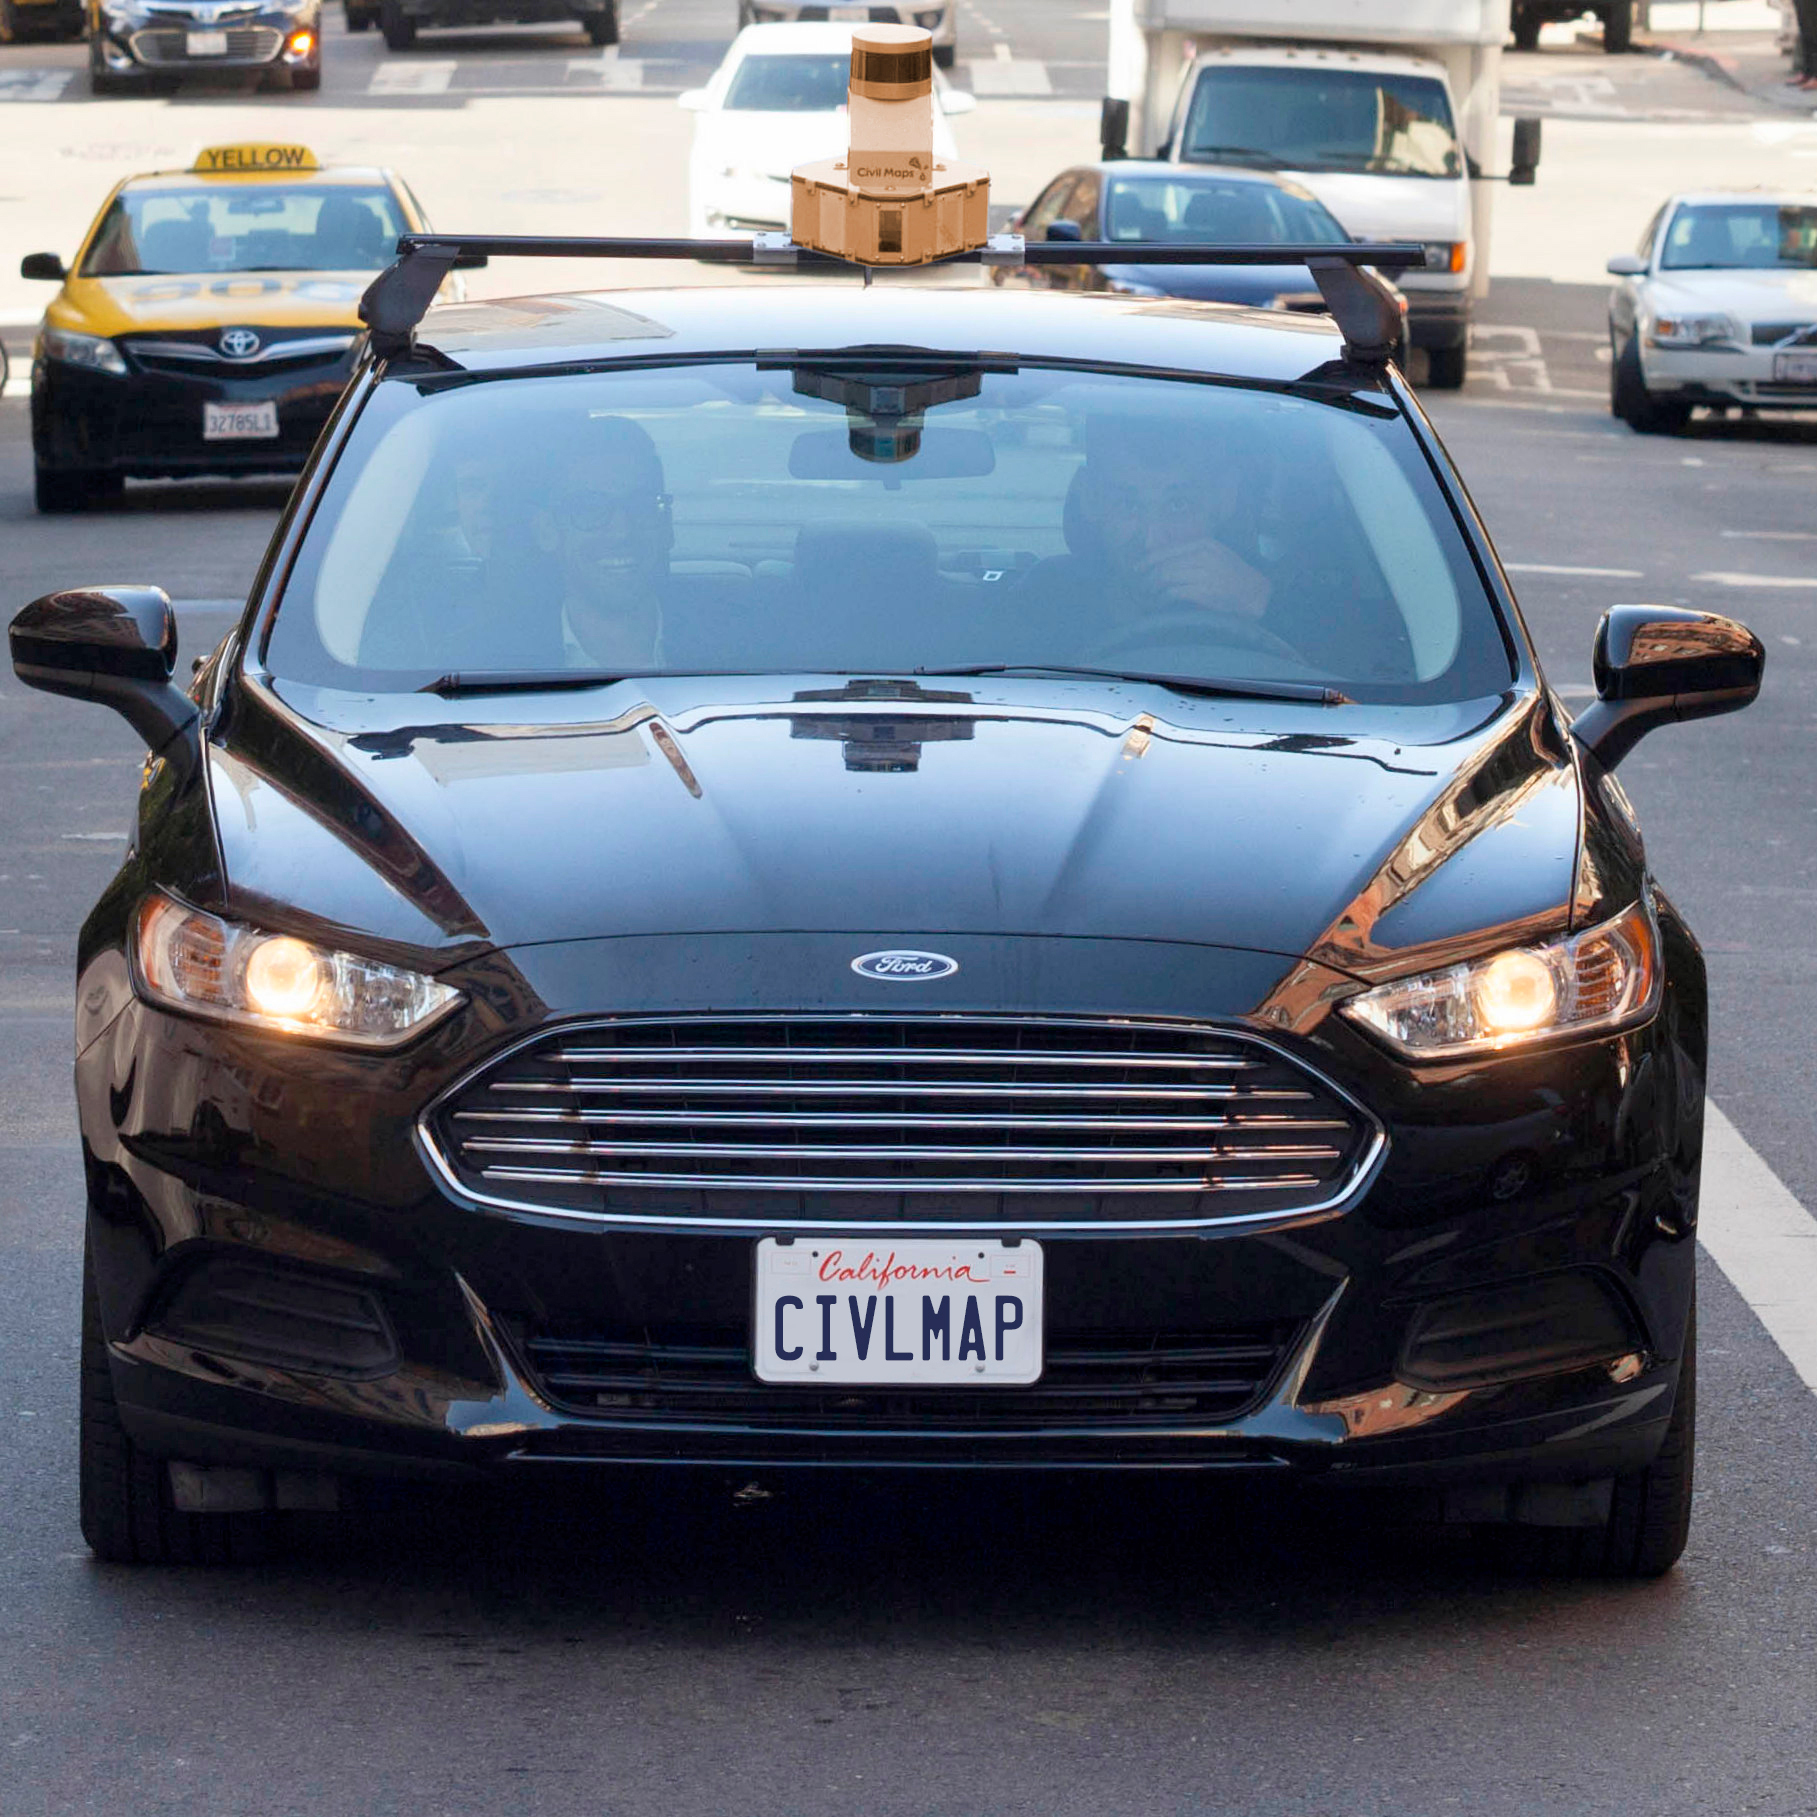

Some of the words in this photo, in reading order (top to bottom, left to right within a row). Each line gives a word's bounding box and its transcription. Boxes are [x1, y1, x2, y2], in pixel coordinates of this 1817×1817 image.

[207, 147, 305, 169] YELLOW
[857, 167, 882, 178] Civil
[883, 167, 915, 179] Maps
[875, 956, 933, 973] Ford
[818, 1250, 991, 1291] California
[774, 1294, 1024, 1362] CIVLMAP
